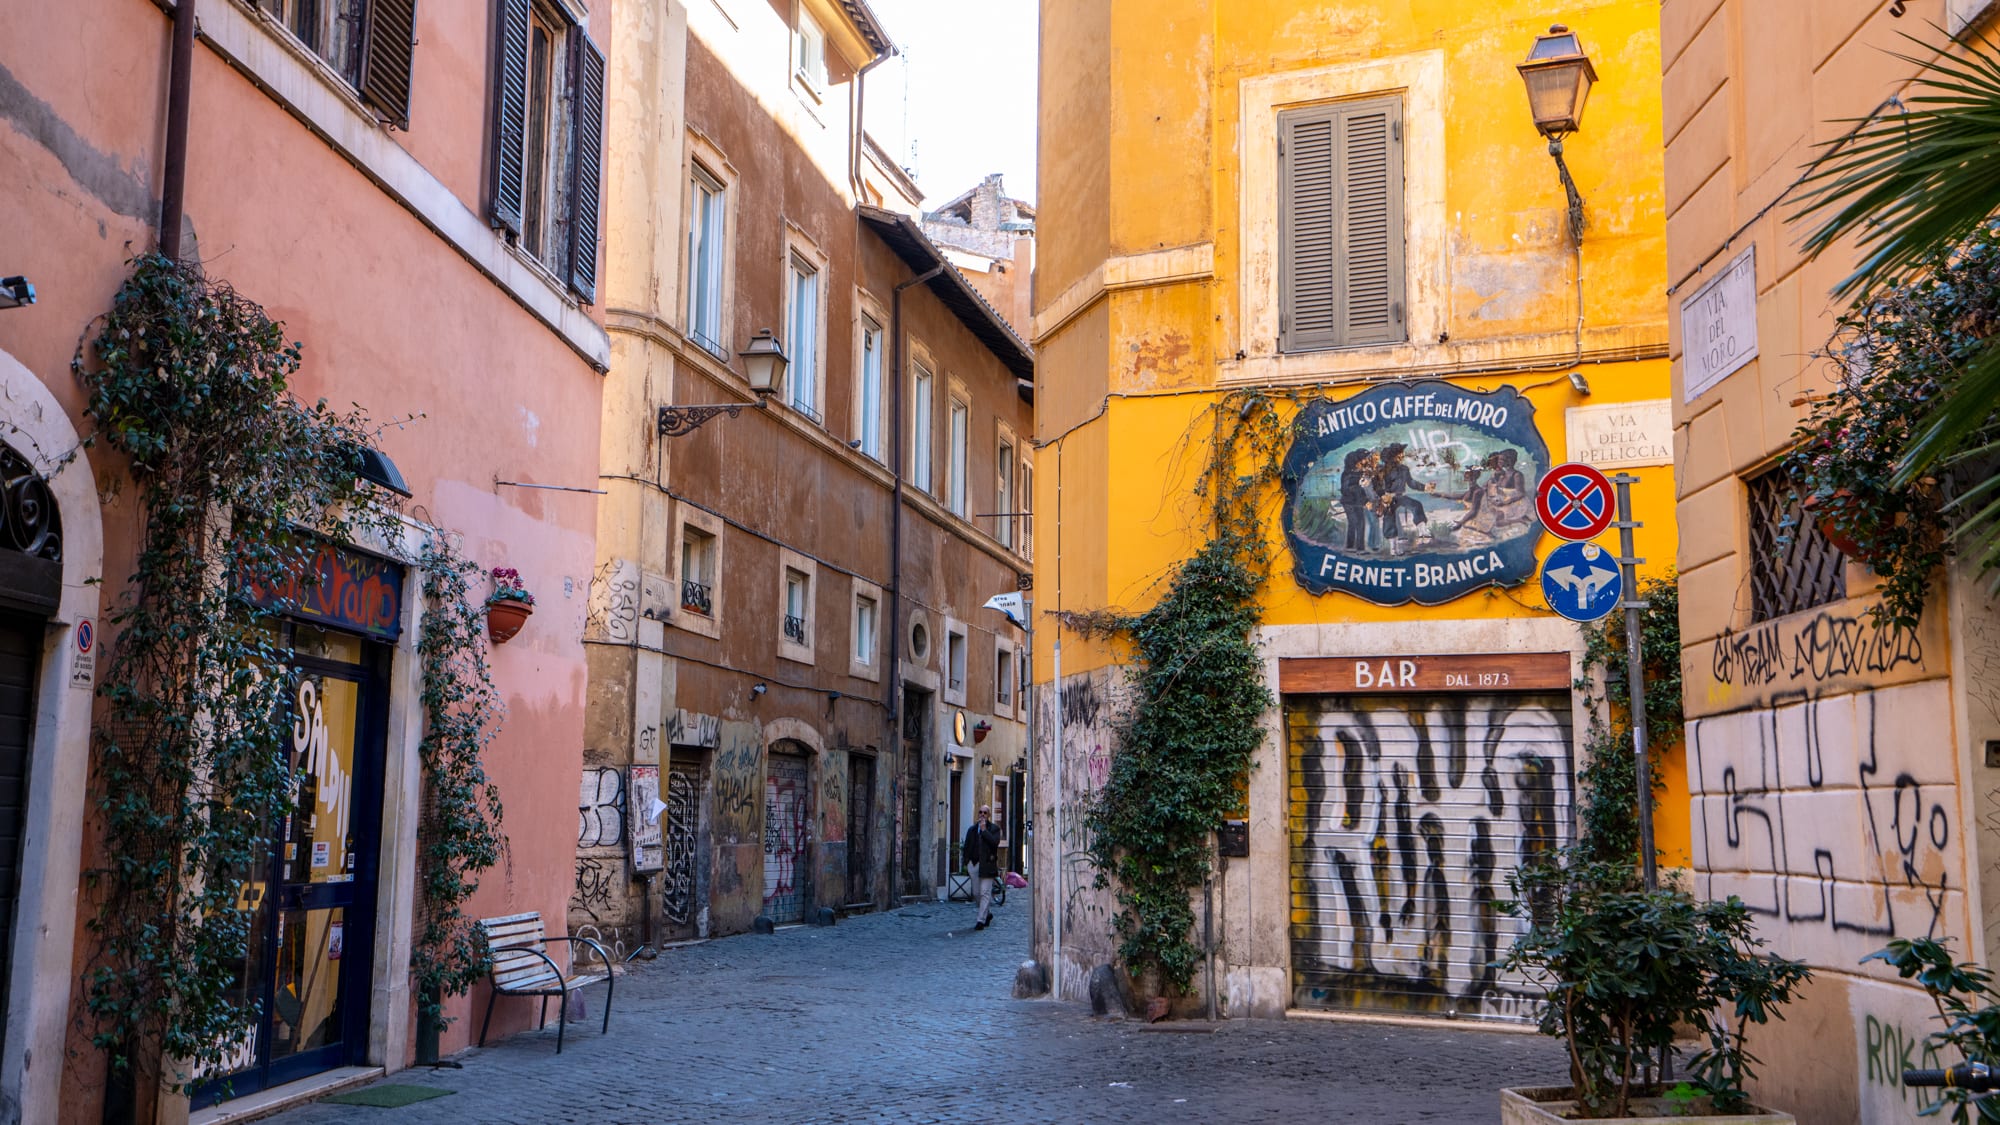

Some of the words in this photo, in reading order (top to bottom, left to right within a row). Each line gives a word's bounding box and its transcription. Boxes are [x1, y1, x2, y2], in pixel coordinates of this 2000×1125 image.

[1706, 290, 1726, 317] VIA
[1709, 317, 1725, 343] DEL
[1702, 335, 1736, 374] MORO
[1317, 401, 1377, 438] ANTICO
[1435, 404, 1452, 418] DEL
[1454, 398, 1508, 429] MORO
[1608, 415, 1638, 427] VIA
[1599, 431, 1648, 445] DELLA
[1580, 445, 1669, 463] PELLICCIA
[1319, 550, 1505, 588] FERNET-BRANCA
[1355, 660, 1417, 688] BAR
[1446, 674, 1471, 687] DAL
[1478, 673, 1510, 687] 1873
